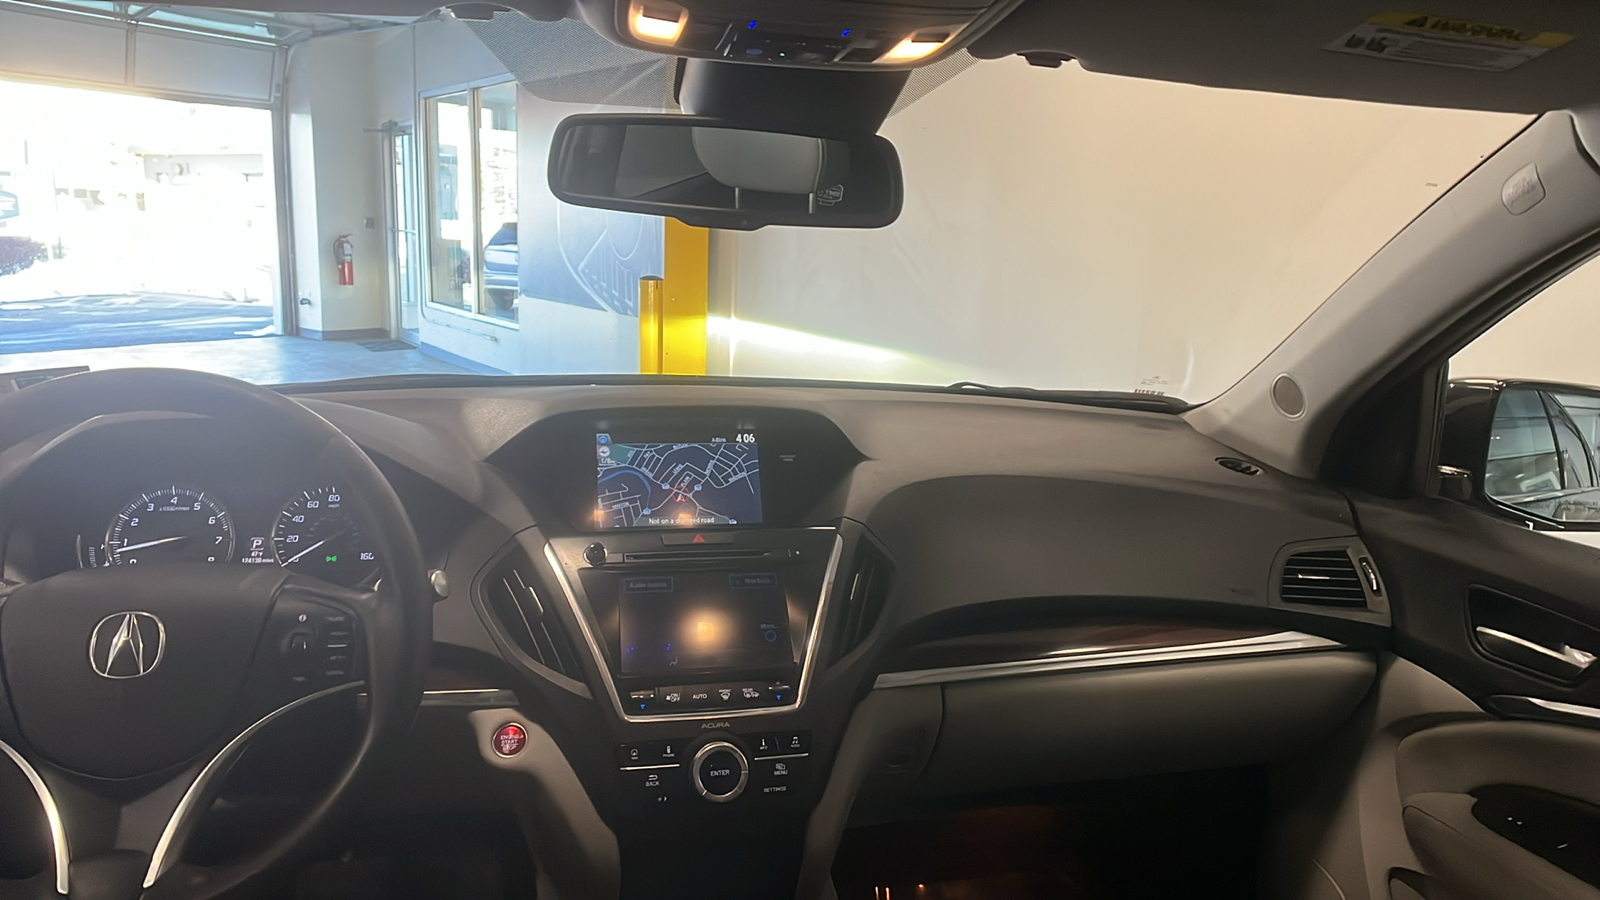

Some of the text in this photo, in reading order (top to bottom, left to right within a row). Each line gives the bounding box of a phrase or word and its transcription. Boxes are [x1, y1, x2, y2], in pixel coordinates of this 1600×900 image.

[170, 496, 178, 504] 4
[328, 494, 340, 502] 80
[146, 503, 154, 511] 3
[194, 502, 201, 511] 5
[131, 518, 139, 526] 2
[208, 516, 216, 524] 6
[292, 515, 304, 523] 40
[123, 538, 128, 546] 1
[214, 536, 222, 545] 7
[286, 534, 299, 542] 20
